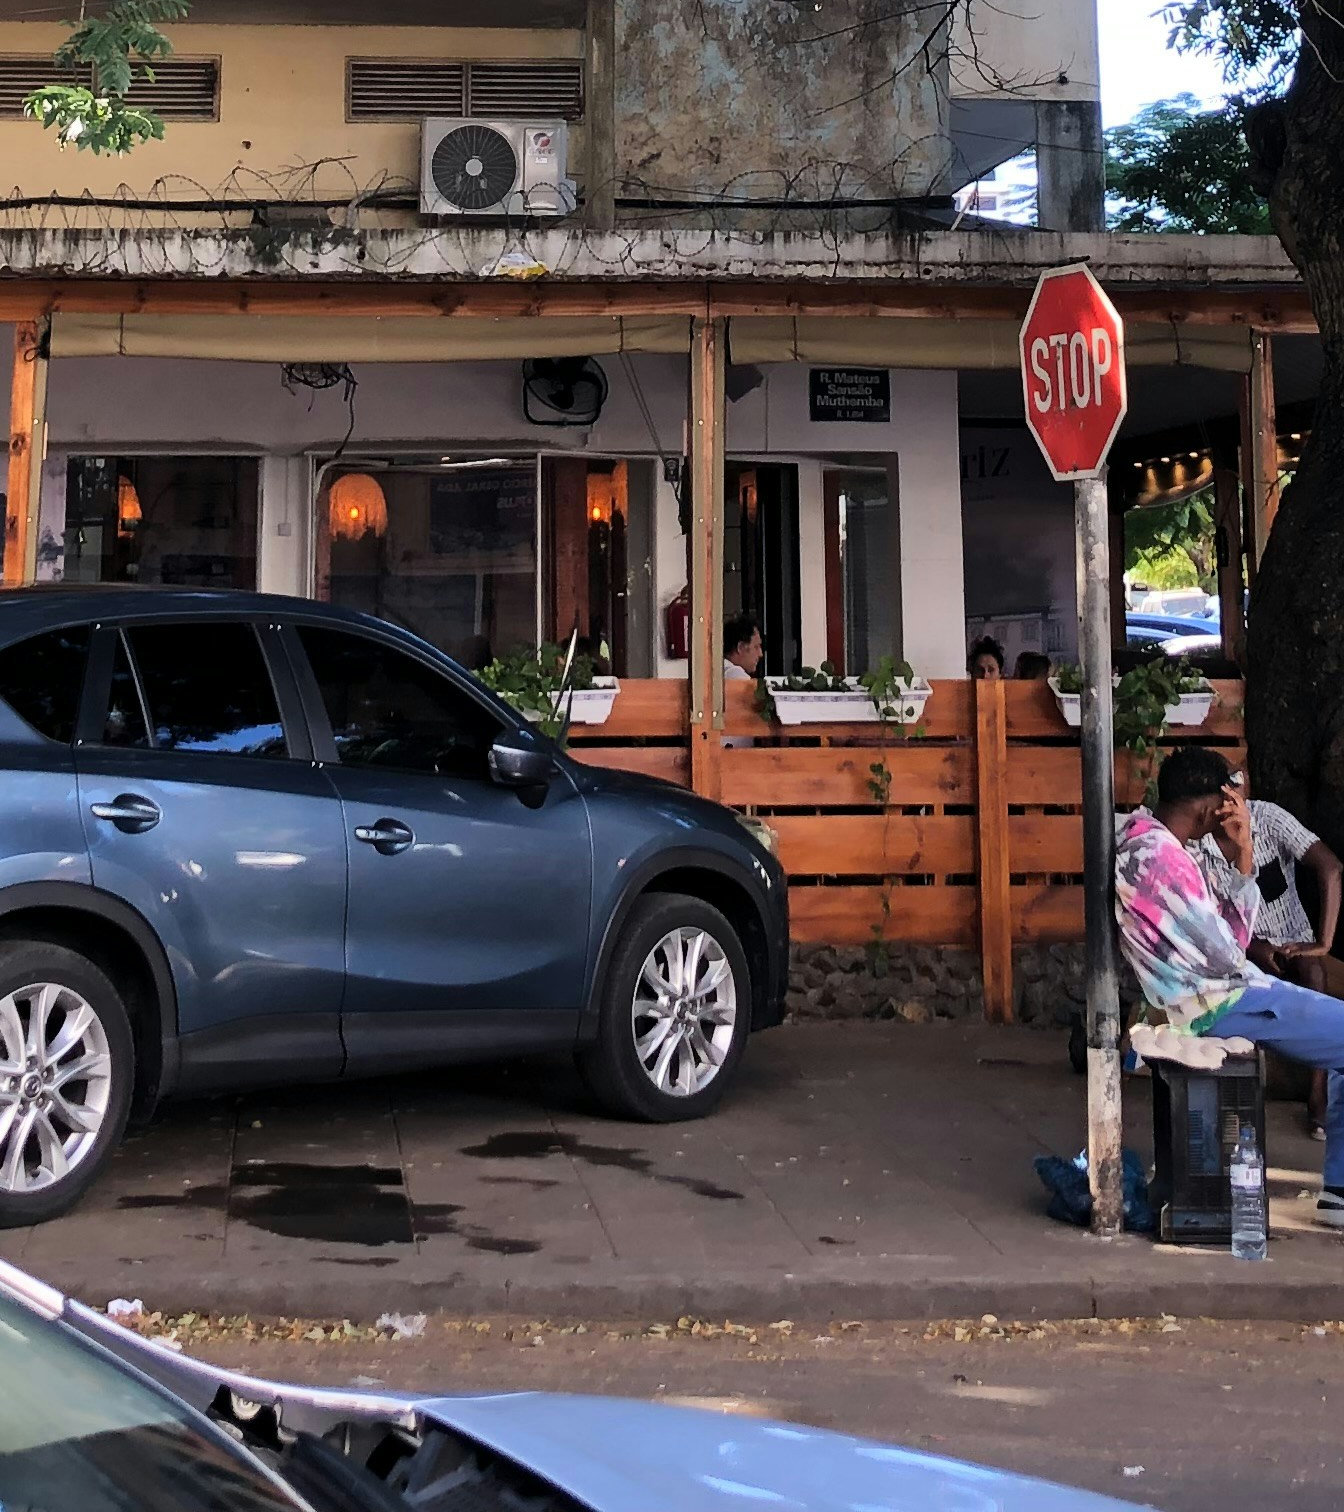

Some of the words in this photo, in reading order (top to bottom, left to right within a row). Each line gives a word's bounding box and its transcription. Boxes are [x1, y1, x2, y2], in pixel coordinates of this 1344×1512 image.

[1031, 327, 1112, 413] STOP
[820, 372, 832, 383] R.
[834, 372, 880, 384] Mateus
[816, 395, 884, 407] Muthemba
